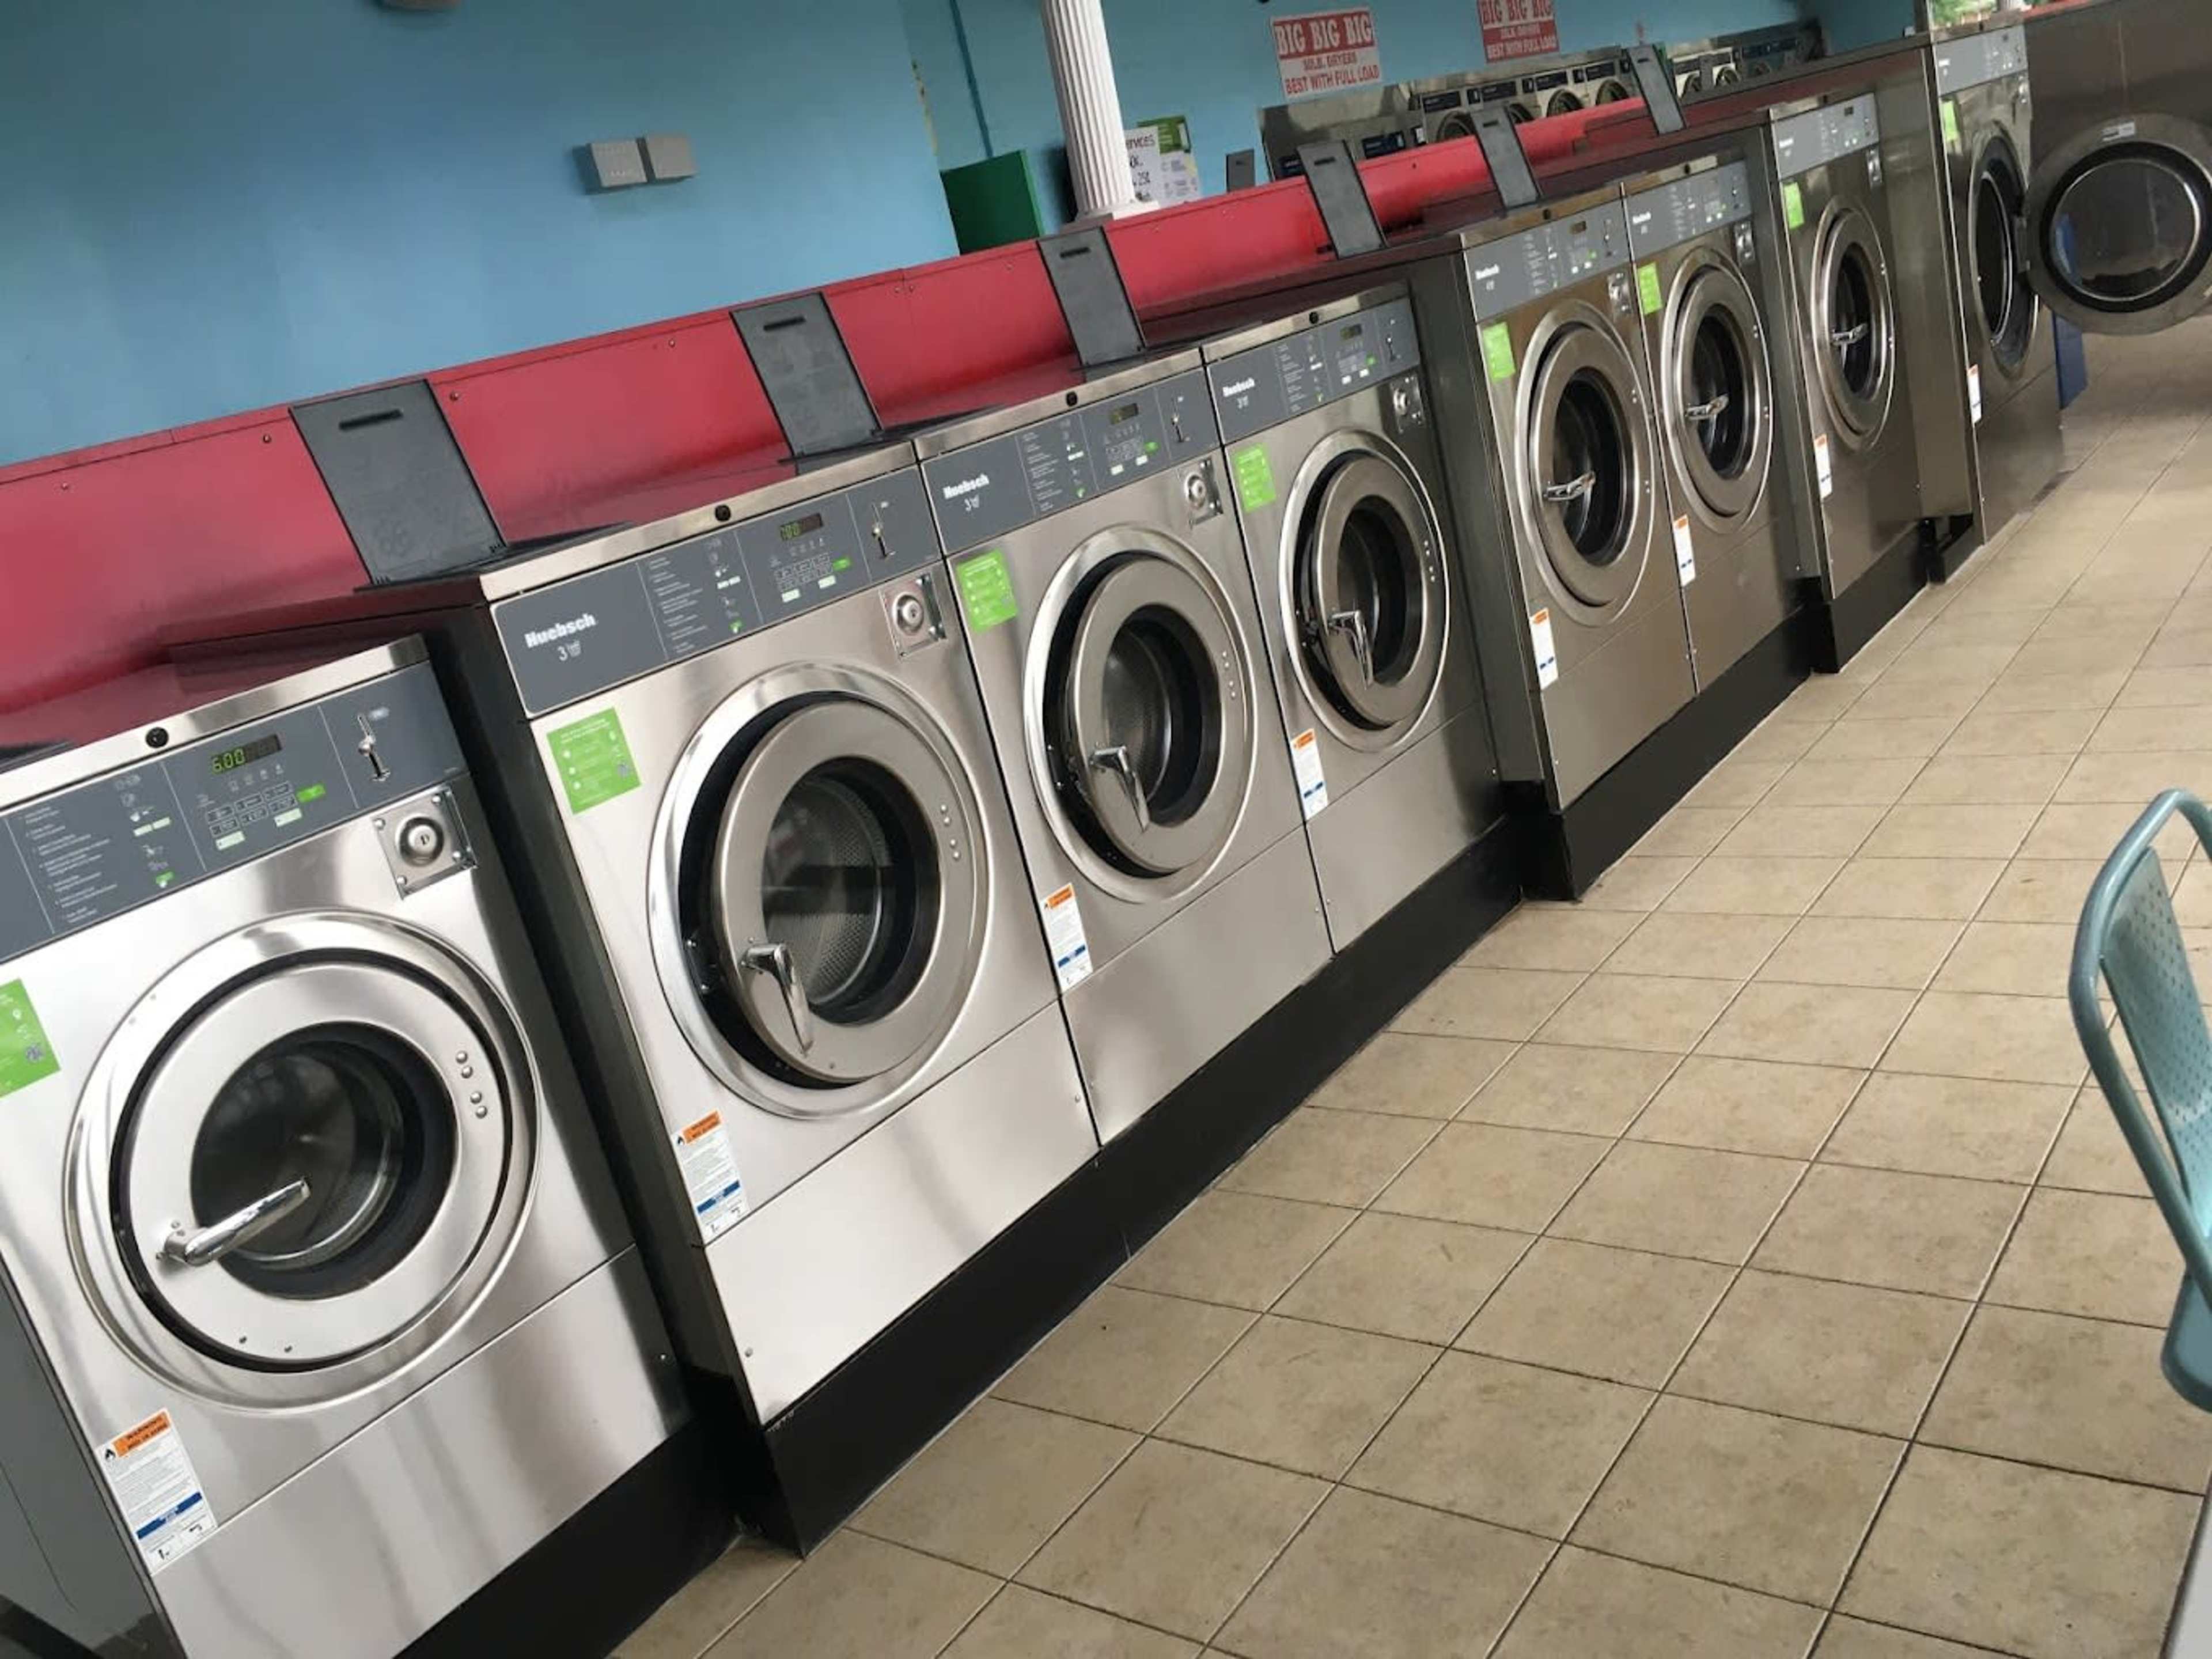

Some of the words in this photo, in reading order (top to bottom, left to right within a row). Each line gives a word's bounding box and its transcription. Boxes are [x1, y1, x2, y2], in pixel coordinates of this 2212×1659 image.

[1480, 0, 1502, 24] BIG
[1506, 0, 1527, 21] BIG
[1533, 0, 1551, 18] BIG
[1275, 23, 1306, 55] BIG
[1309, 19, 1340, 51] BIG
[1343, 14, 1373, 45] BIG
[1285, 76, 1308, 94] BEST
[1310, 73, 1333, 89] WITH
[1335, 69, 1355, 85] FULL
[1358, 65, 1380, 82] LOAD
[524, 613, 596, 649] Huebsch
